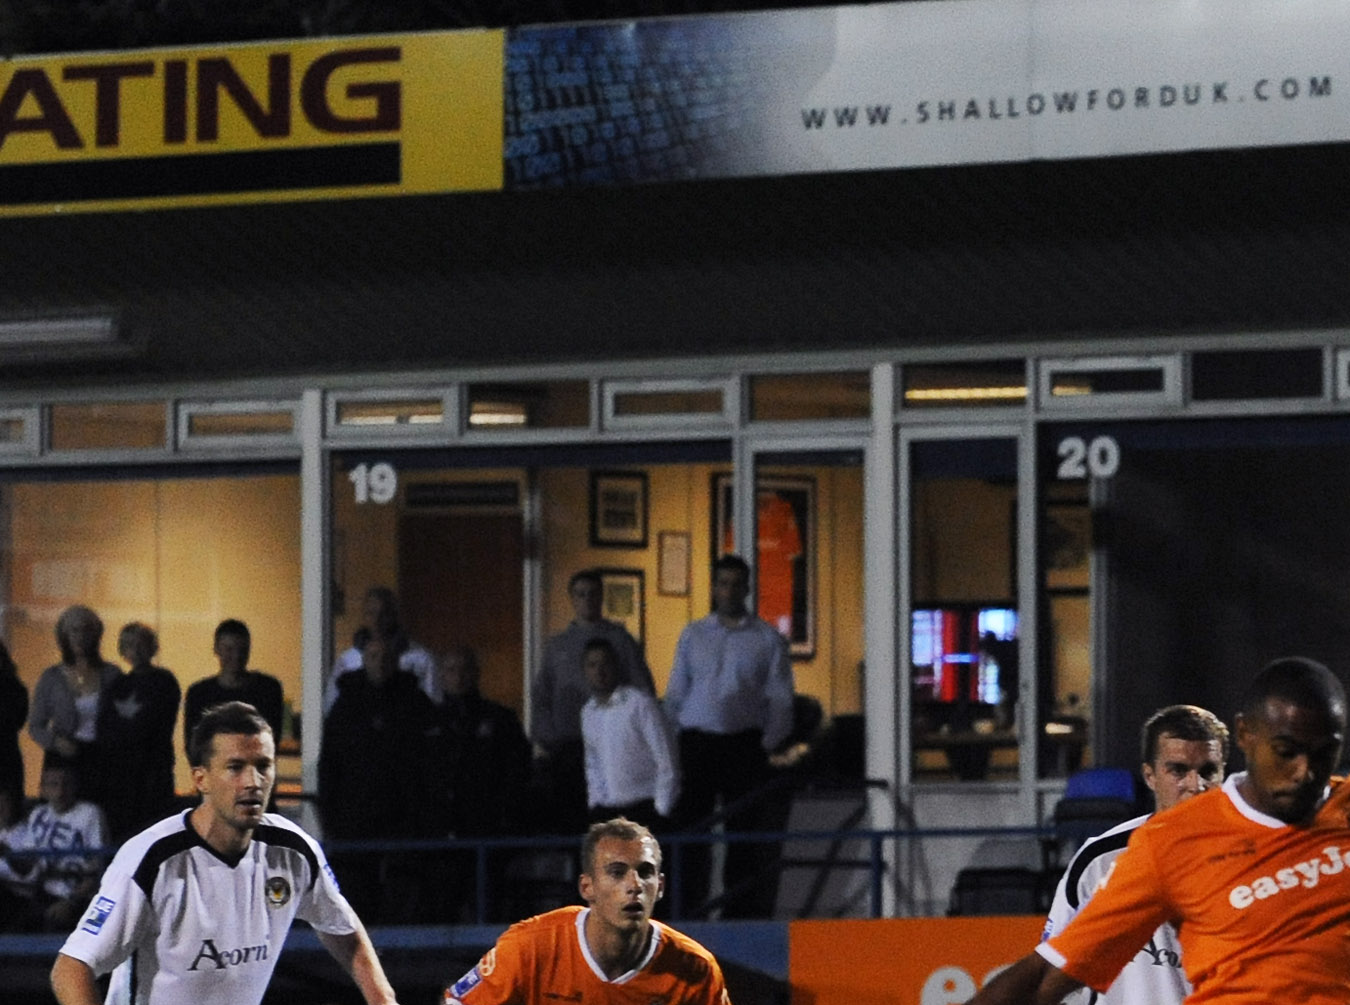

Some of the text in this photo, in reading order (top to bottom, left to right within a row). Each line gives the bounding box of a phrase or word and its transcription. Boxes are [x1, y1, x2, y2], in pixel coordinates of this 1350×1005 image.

[0, 46, 400, 149] ATING
[802, 76, 1333, 130] WWW.SHALLOWFORDUK.COM
[1056, 436, 1120, 478] 20
[349, 462, 397, 504] 19
[187, 939, 268, 971] Acorn
